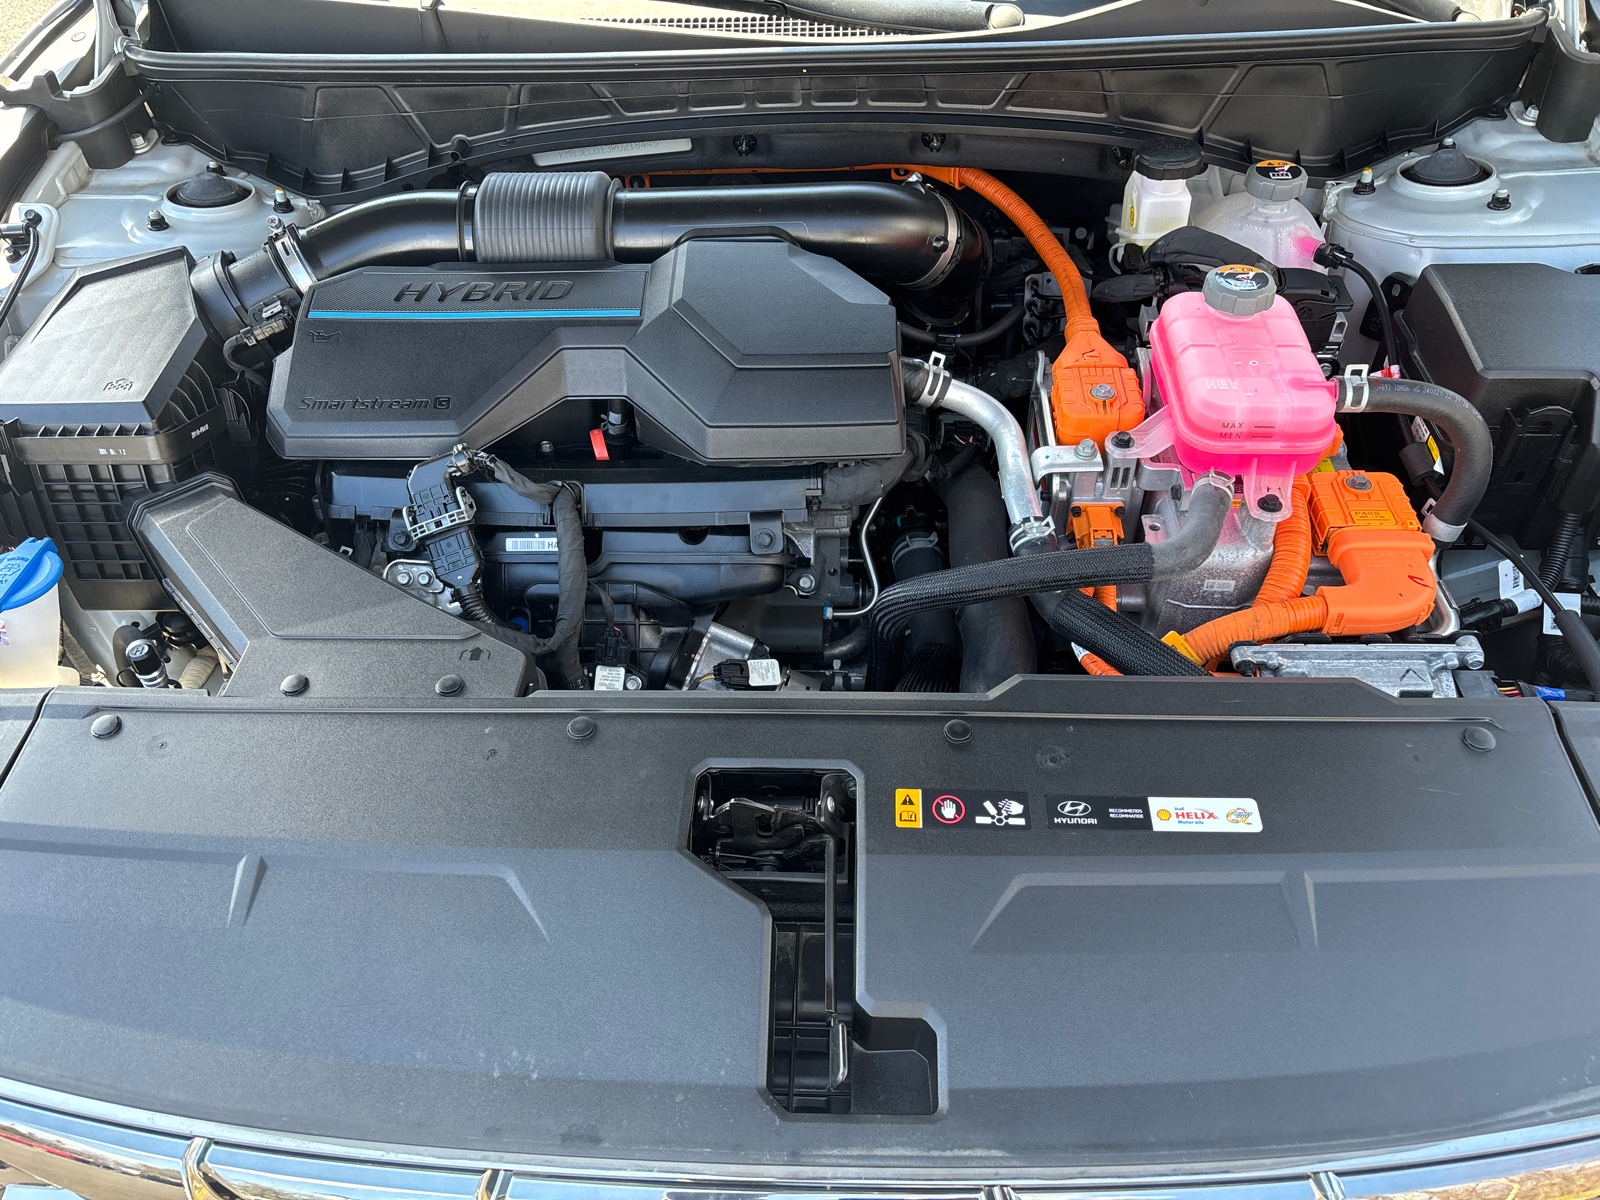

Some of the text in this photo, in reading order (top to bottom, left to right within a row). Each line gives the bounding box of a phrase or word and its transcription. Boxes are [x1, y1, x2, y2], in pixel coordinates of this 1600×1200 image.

[393, 280, 574, 302] HYBRID
[298, 396, 452, 411] Smartstream G
[1175, 811, 1218, 819] HELIX
[1054, 817, 1098, 825] HYUNDAI
